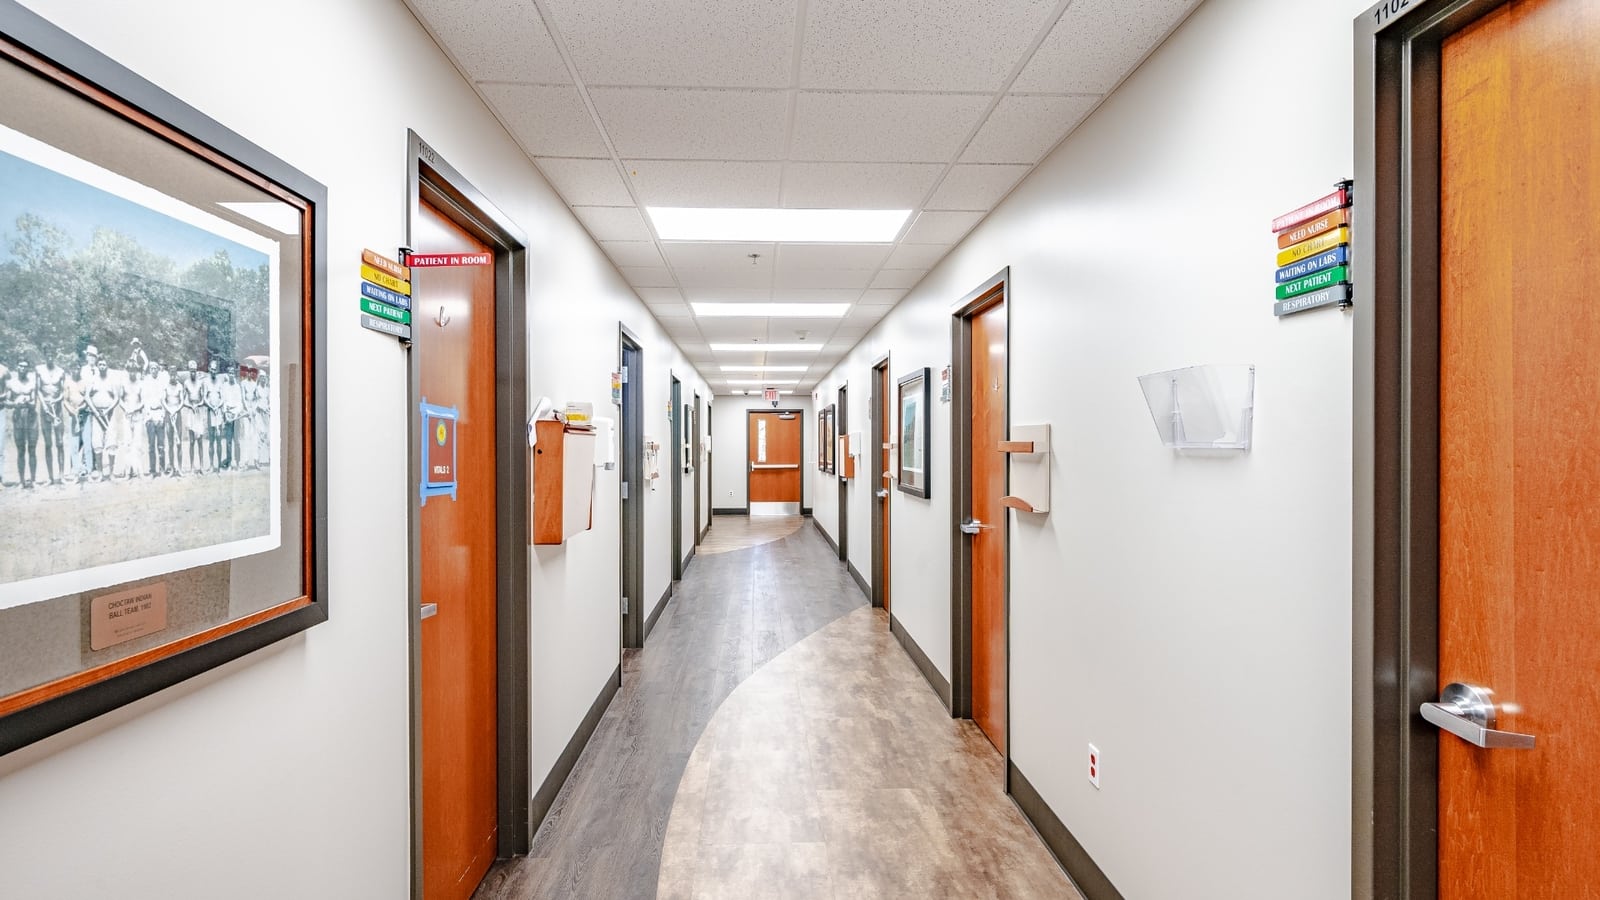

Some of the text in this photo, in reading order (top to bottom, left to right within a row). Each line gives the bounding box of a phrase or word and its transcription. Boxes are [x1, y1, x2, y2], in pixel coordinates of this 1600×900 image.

[418, 141, 435, 164] 11022
[1288, 218, 1329, 241] NEED NURSE
[1292, 238, 1325, 257] NO CHART
[414, 255, 487, 265] PATIENT IN ROOM
[1279, 252, 1337, 279] WAITING ON LABS
[1285, 271, 1333, 295] NEXT PATIENT
[366, 285, 387, 300] WAITING
[395, 295, 408, 307] LABS
[1282, 291, 1330, 312] RESPIRATORY
[368, 302, 403, 320] NEXT PATIENT
[108, 597, 135, 609] CHOCTAW
[108, 610, 124, 620] BALL
